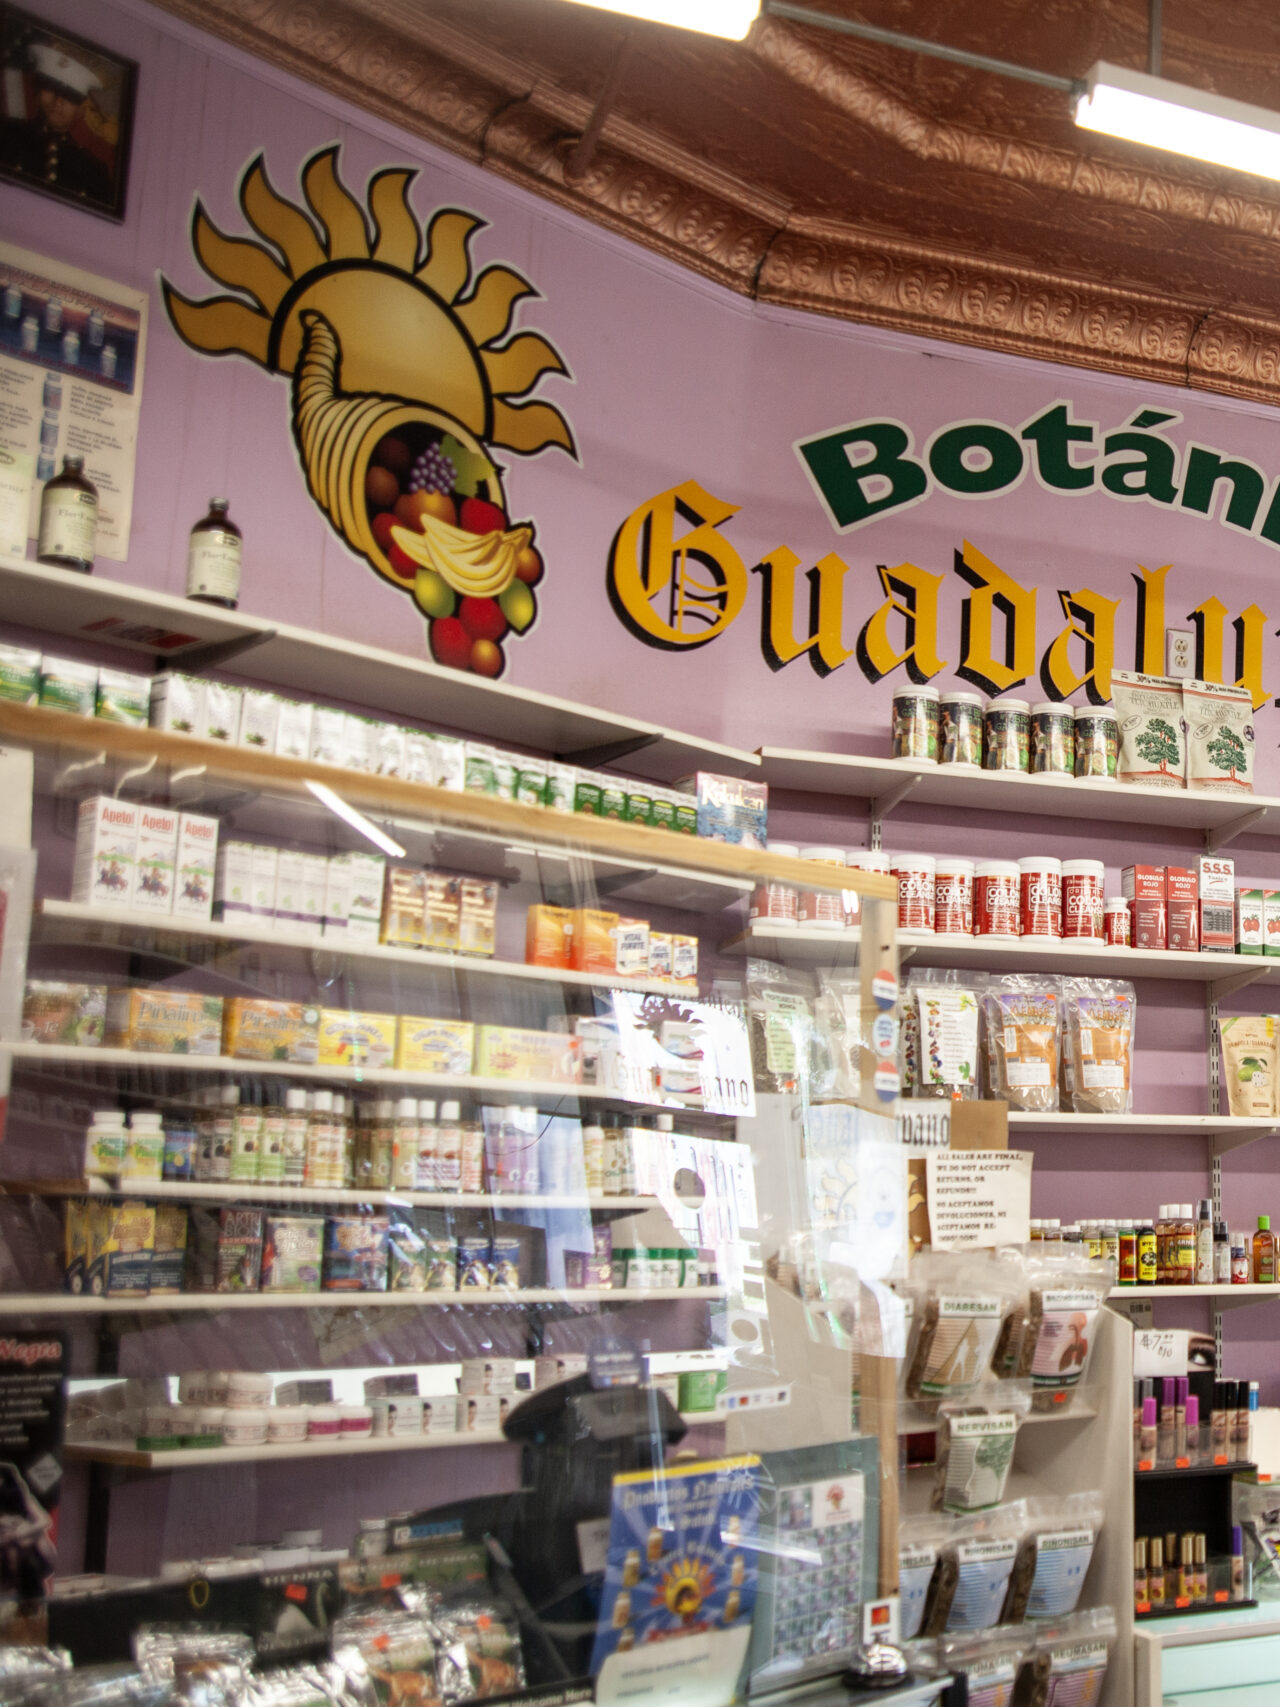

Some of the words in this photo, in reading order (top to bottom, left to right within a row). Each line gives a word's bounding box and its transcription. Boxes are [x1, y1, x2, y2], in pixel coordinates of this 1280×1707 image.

[1137, 873, 1165, 882] GLOBULO
[1169, 875, 1197, 884] GLOBULO
[1142, 880, 1159, 888] ROJO
[943, 1301, 997, 1313] DIABESAN
[957, 1420, 1014, 1433] NERVISAN
[264, 1568, 335, 1585] HENNA
